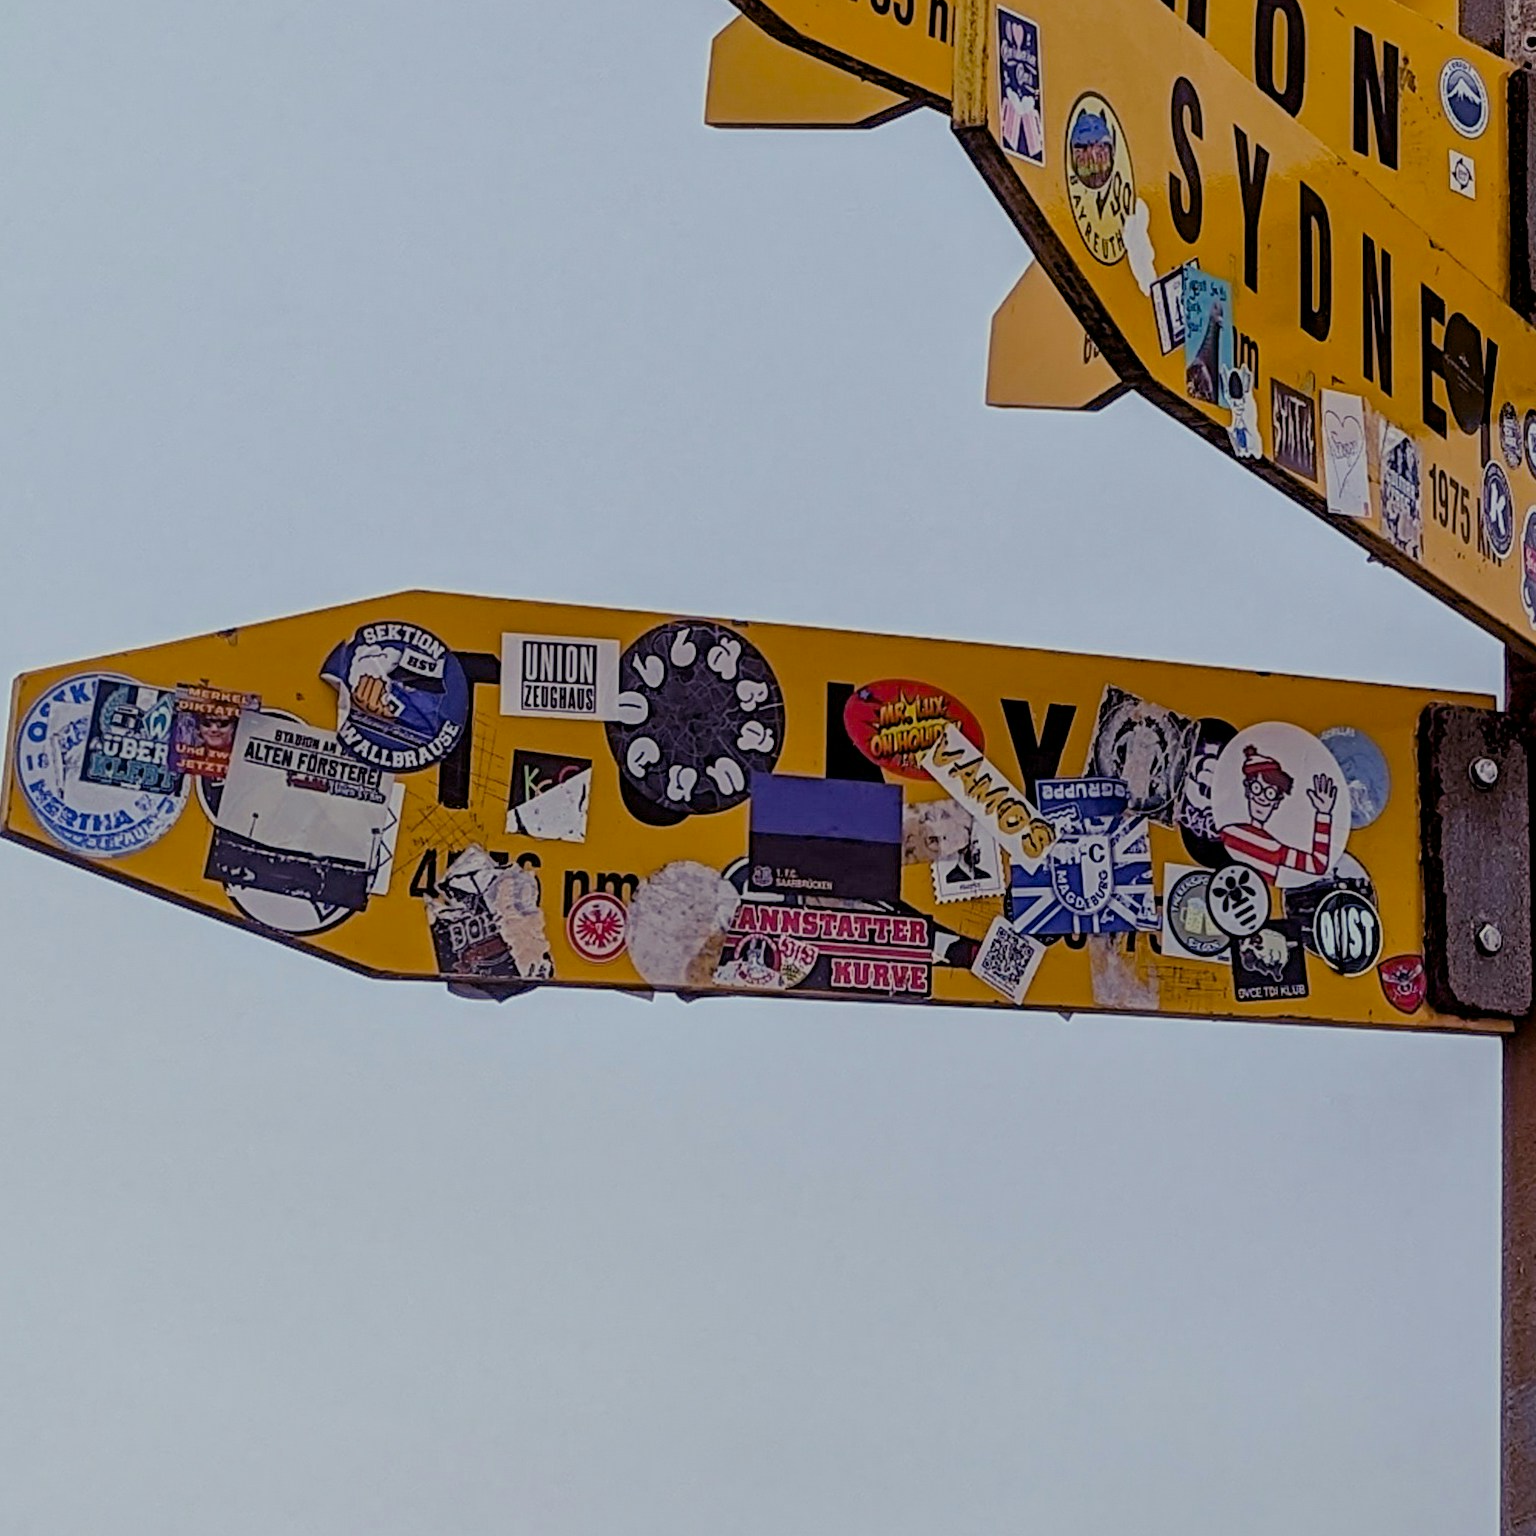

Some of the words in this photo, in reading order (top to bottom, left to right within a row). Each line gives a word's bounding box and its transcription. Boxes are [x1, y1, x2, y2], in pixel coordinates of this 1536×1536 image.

[1429, 463, 1471, 545] 1975
[362, 623, 446, 660] SEKTION
[525, 642, 594, 684] UNION
[523, 684, 593, 711] ZEUGHAUS
[244, 742, 293, 768] ALTEN
[339, 720, 460, 769] WALLBRAUSE
[933, 731, 1058, 859] VAMOS
[1056, 869, 1109, 910] MAGDEBURG
[730, 904, 929, 946] ANNSTATTER
[831, 958, 928, 993] KURVE
